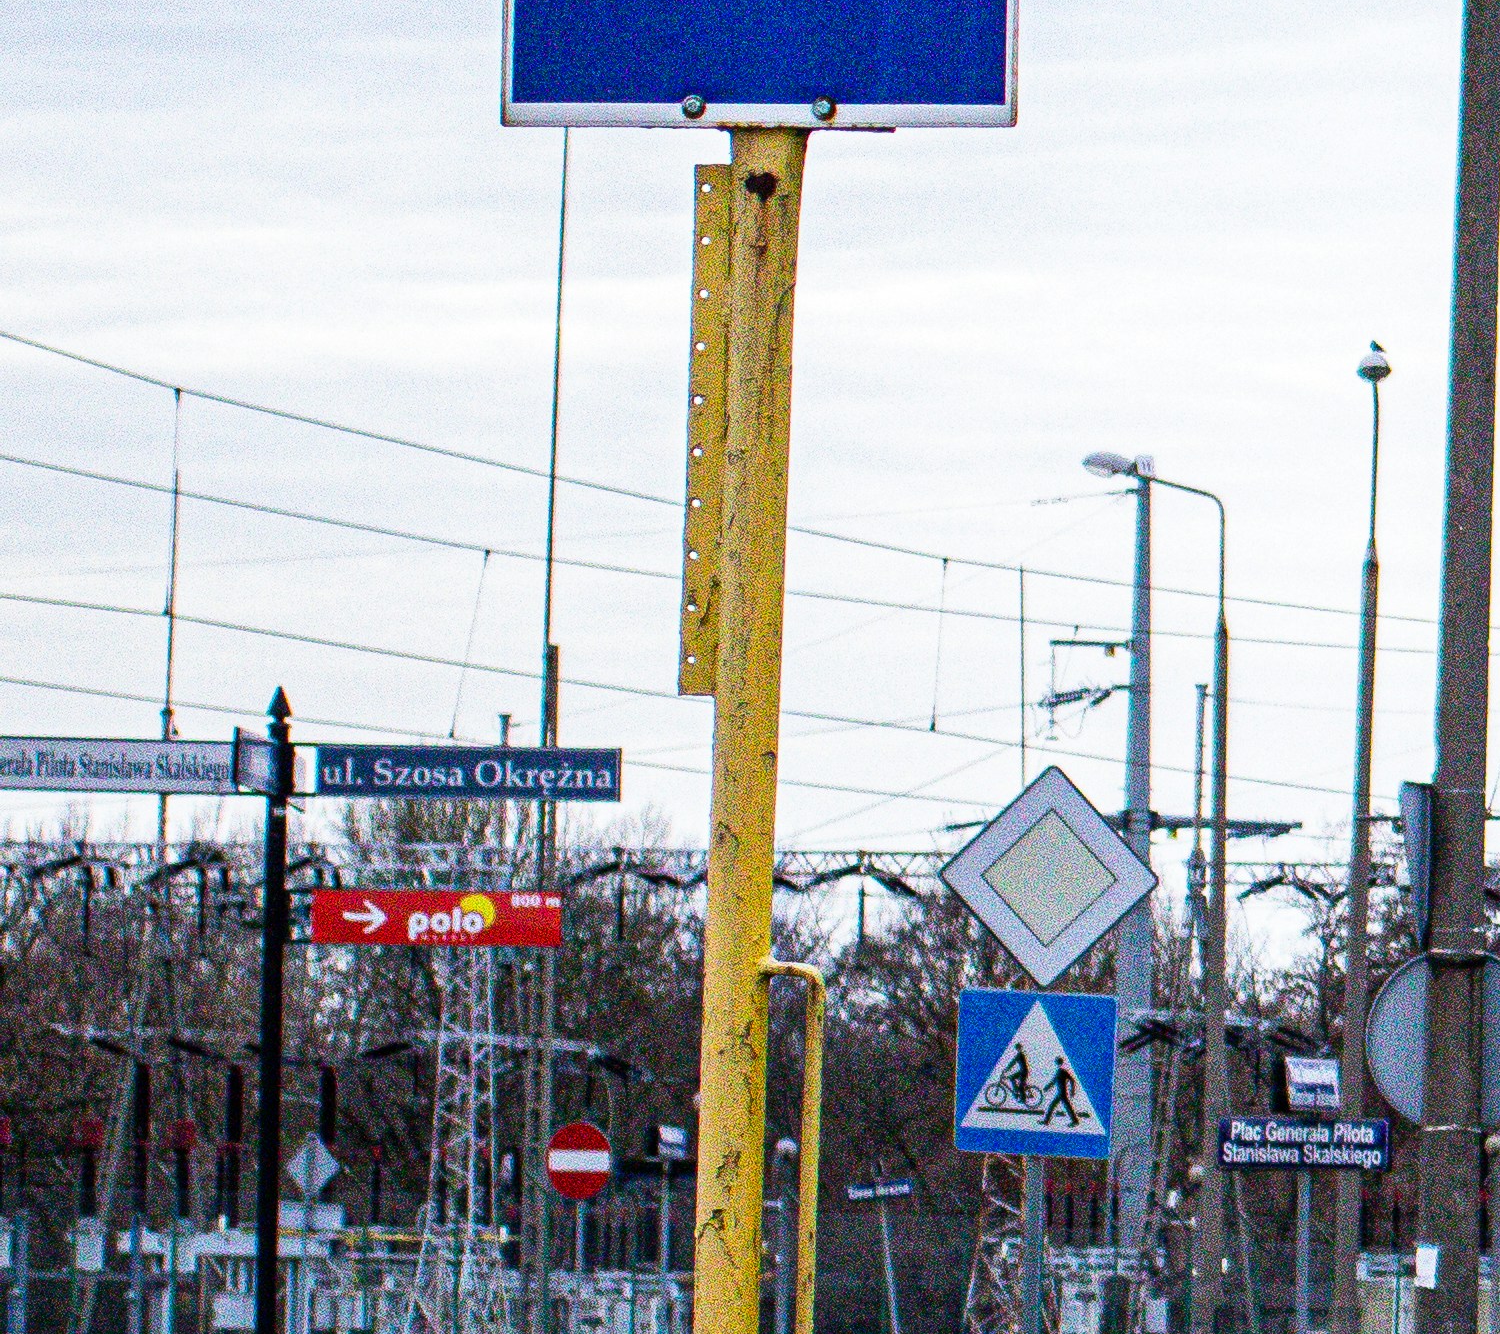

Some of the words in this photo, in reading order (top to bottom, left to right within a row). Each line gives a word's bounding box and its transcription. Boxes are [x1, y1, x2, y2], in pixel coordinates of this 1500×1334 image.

[323, 758, 362, 785] ul.
[374, 759, 466, 787] Szosa
[475, 759, 613, 792] Okrężna
[545, 896, 561, 908] m
[408, 906, 484, 940] polo
[1231, 1120, 1262, 1141] Plac
[1333, 1122, 1375, 1144] Pilota
[1303, 1143, 1381, 1169] Skalskiego
